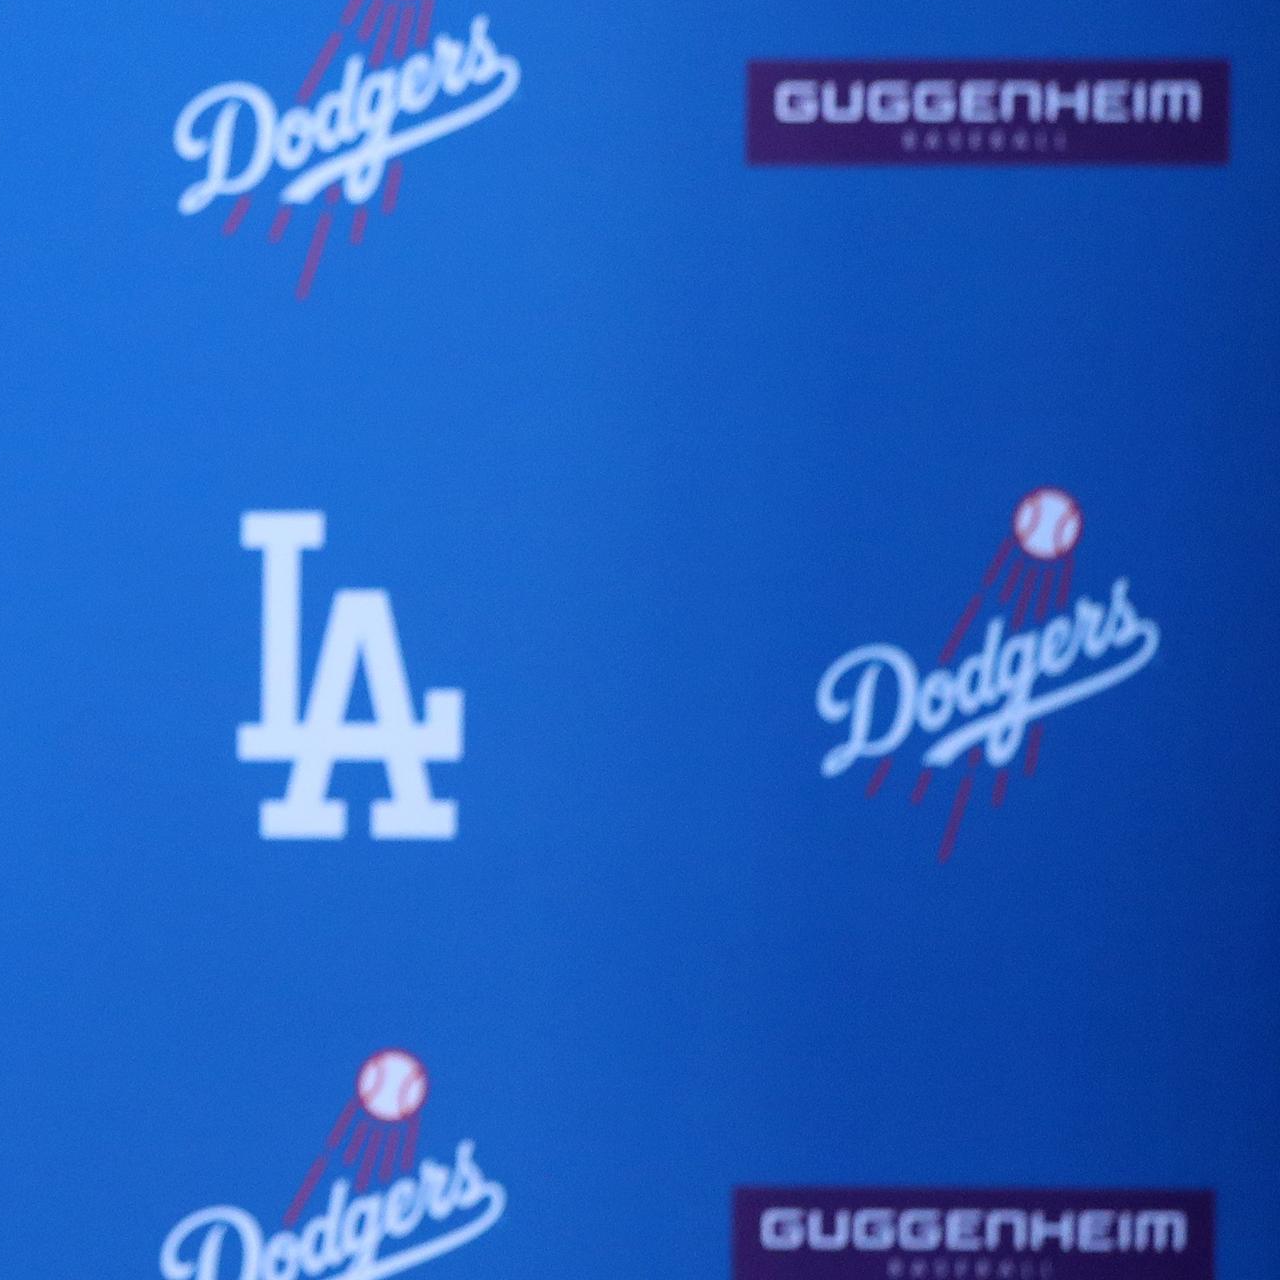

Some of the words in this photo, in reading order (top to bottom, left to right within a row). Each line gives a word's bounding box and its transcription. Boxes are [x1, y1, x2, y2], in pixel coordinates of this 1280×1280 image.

[172, 15, 522, 215] Dodgers
[773, 79, 1201, 124] GUGGENHEIM
[236, 510, 465, 840] LA
[815, 579, 1160, 778] Dodgers
[759, 1207, 1188, 1253] GUGGENHEIM
